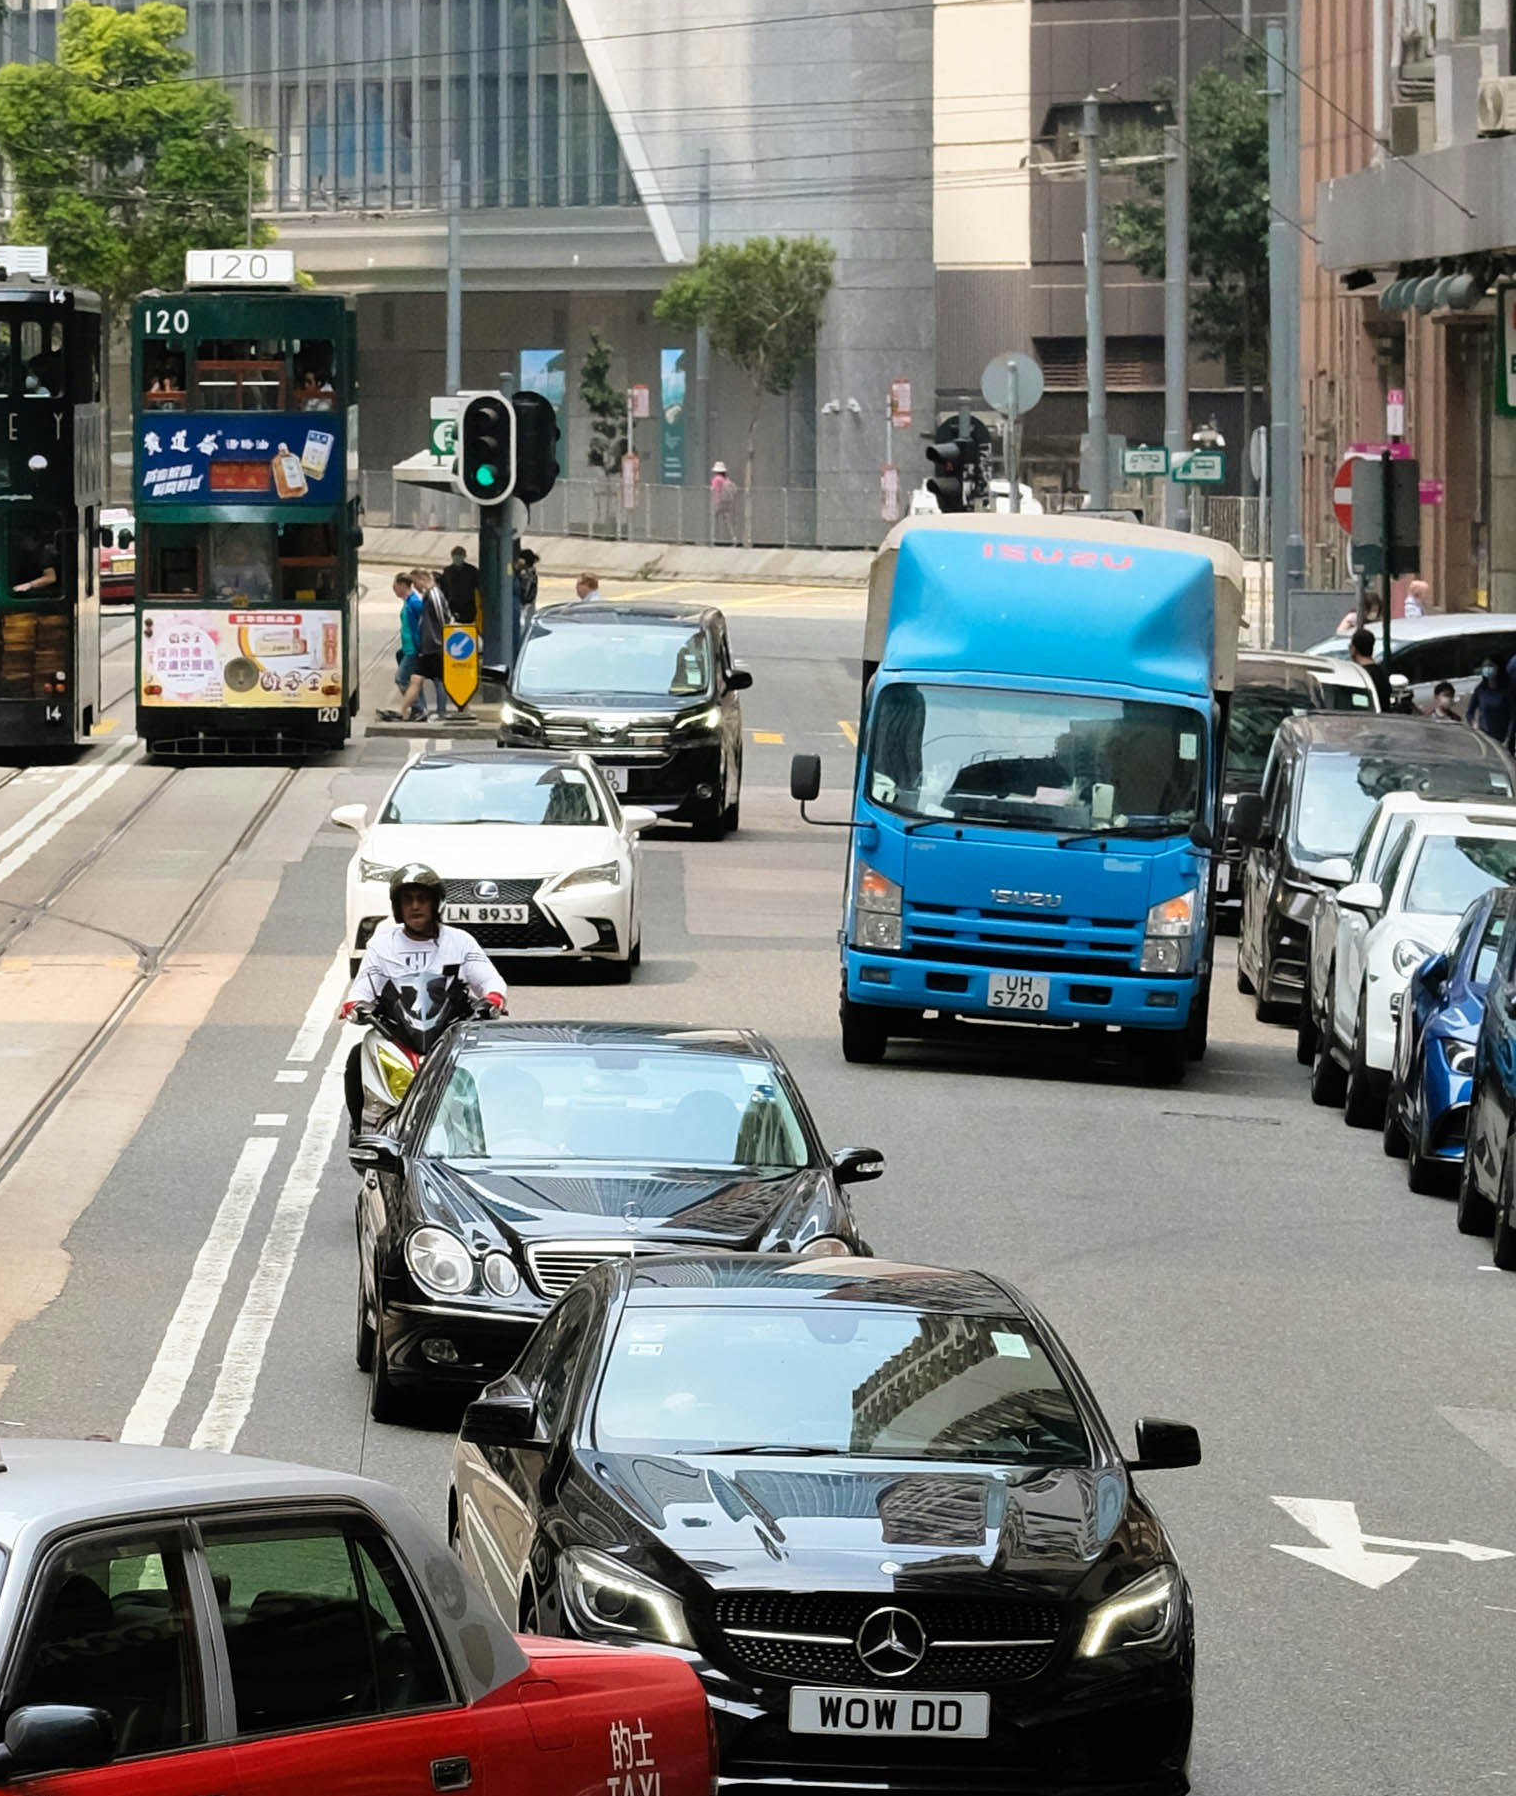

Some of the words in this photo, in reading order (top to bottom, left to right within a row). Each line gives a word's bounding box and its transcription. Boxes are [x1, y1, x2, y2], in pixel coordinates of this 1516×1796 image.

[211, 255, 267, 279] 120
[49, 290, 66, 303] 14
[145, 310, 189, 334] 120
[983, 544, 1133, 570] ISUZU
[46, 705, 62, 721] 14
[318, 708, 339, 722] 120
[990, 889, 1062, 907] ISUZU
[447, 907, 471, 921] LN
[479, 908, 524, 921] 8933
[1006, 975, 1033, 992] UH
[992, 991, 1044, 1009] 5720
[819, 1696, 898, 1730] WOW
[911, 1700, 963, 1732] DD
[609, 1717, 655, 1771] 的士
